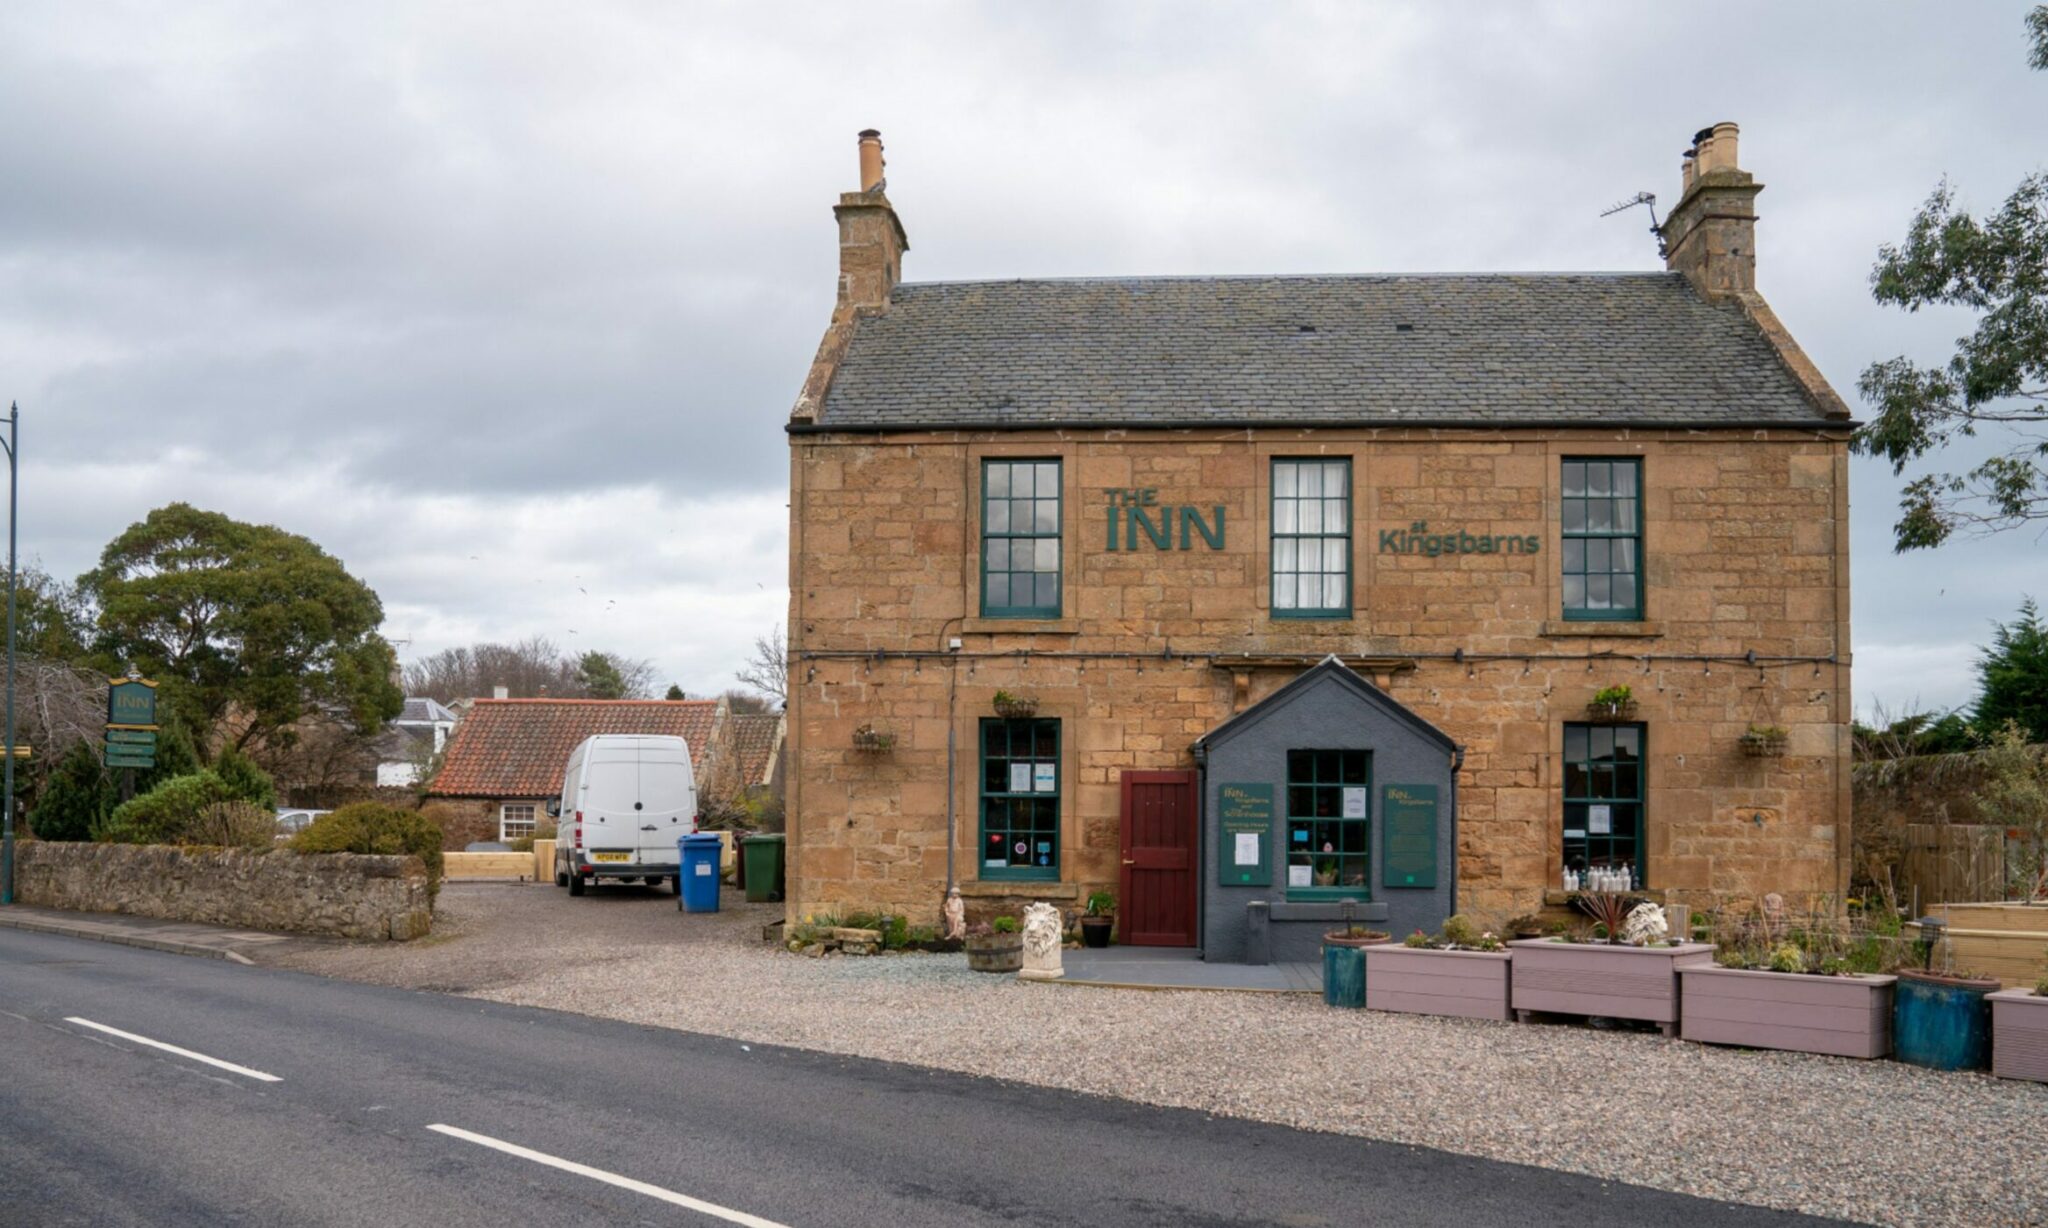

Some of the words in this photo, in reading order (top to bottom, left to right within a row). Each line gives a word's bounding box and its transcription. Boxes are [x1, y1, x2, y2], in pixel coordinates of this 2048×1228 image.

[1103, 487, 1158, 507] THE
[1105, 506, 1226, 551] INN
[1411, 519, 1428, 533] at
[1378, 528, 1540, 557] Kingsbarns
[117, 695, 150, 709] INN
[1224, 789, 1244, 798] INN
[1388, 789, 1408, 799] INN
